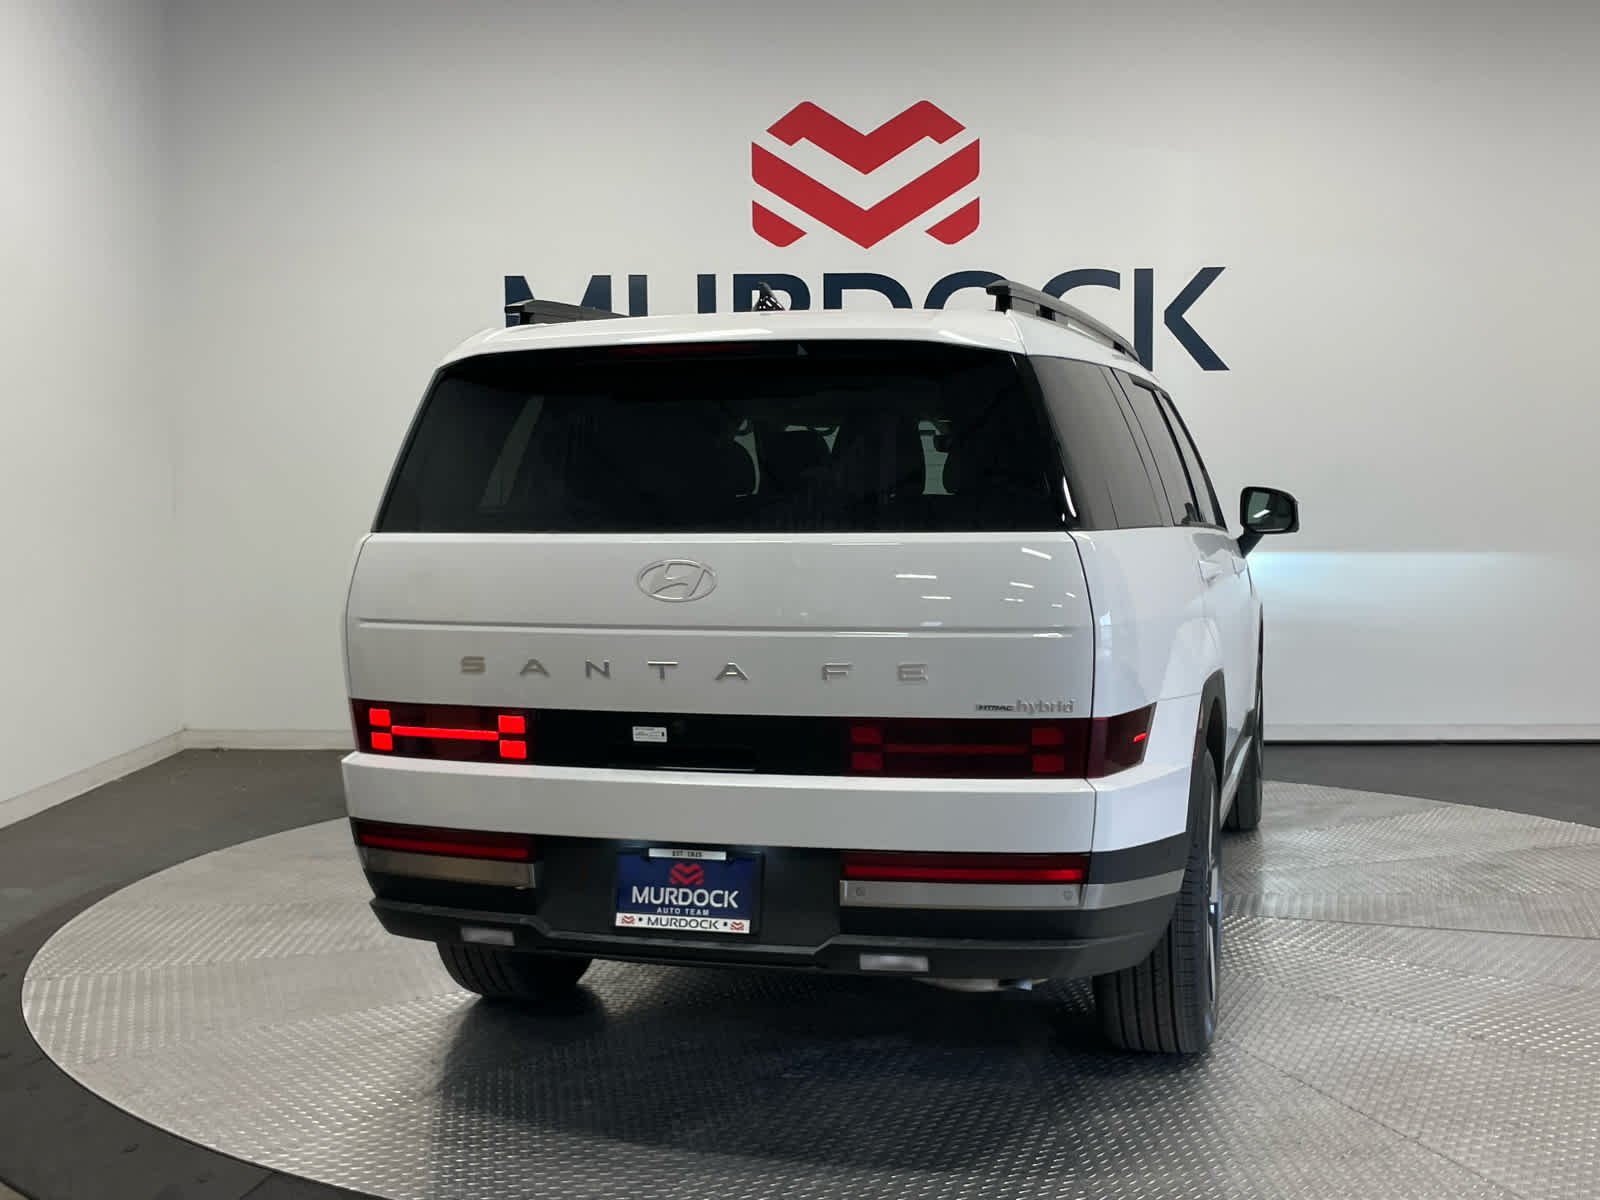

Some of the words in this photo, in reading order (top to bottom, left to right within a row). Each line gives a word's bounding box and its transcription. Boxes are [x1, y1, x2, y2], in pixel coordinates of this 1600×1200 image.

[460, 656, 750, 681] SANTA
[821, 662, 929, 682] FE
[1016, 697, 1075, 715] hybrid
[631, 885, 740, 909] MURDOCK
[656, 907, 681, 915] AUTO
[685, 908, 710, 917] TEAM
[647, 915, 720, 930] MURDOCK
